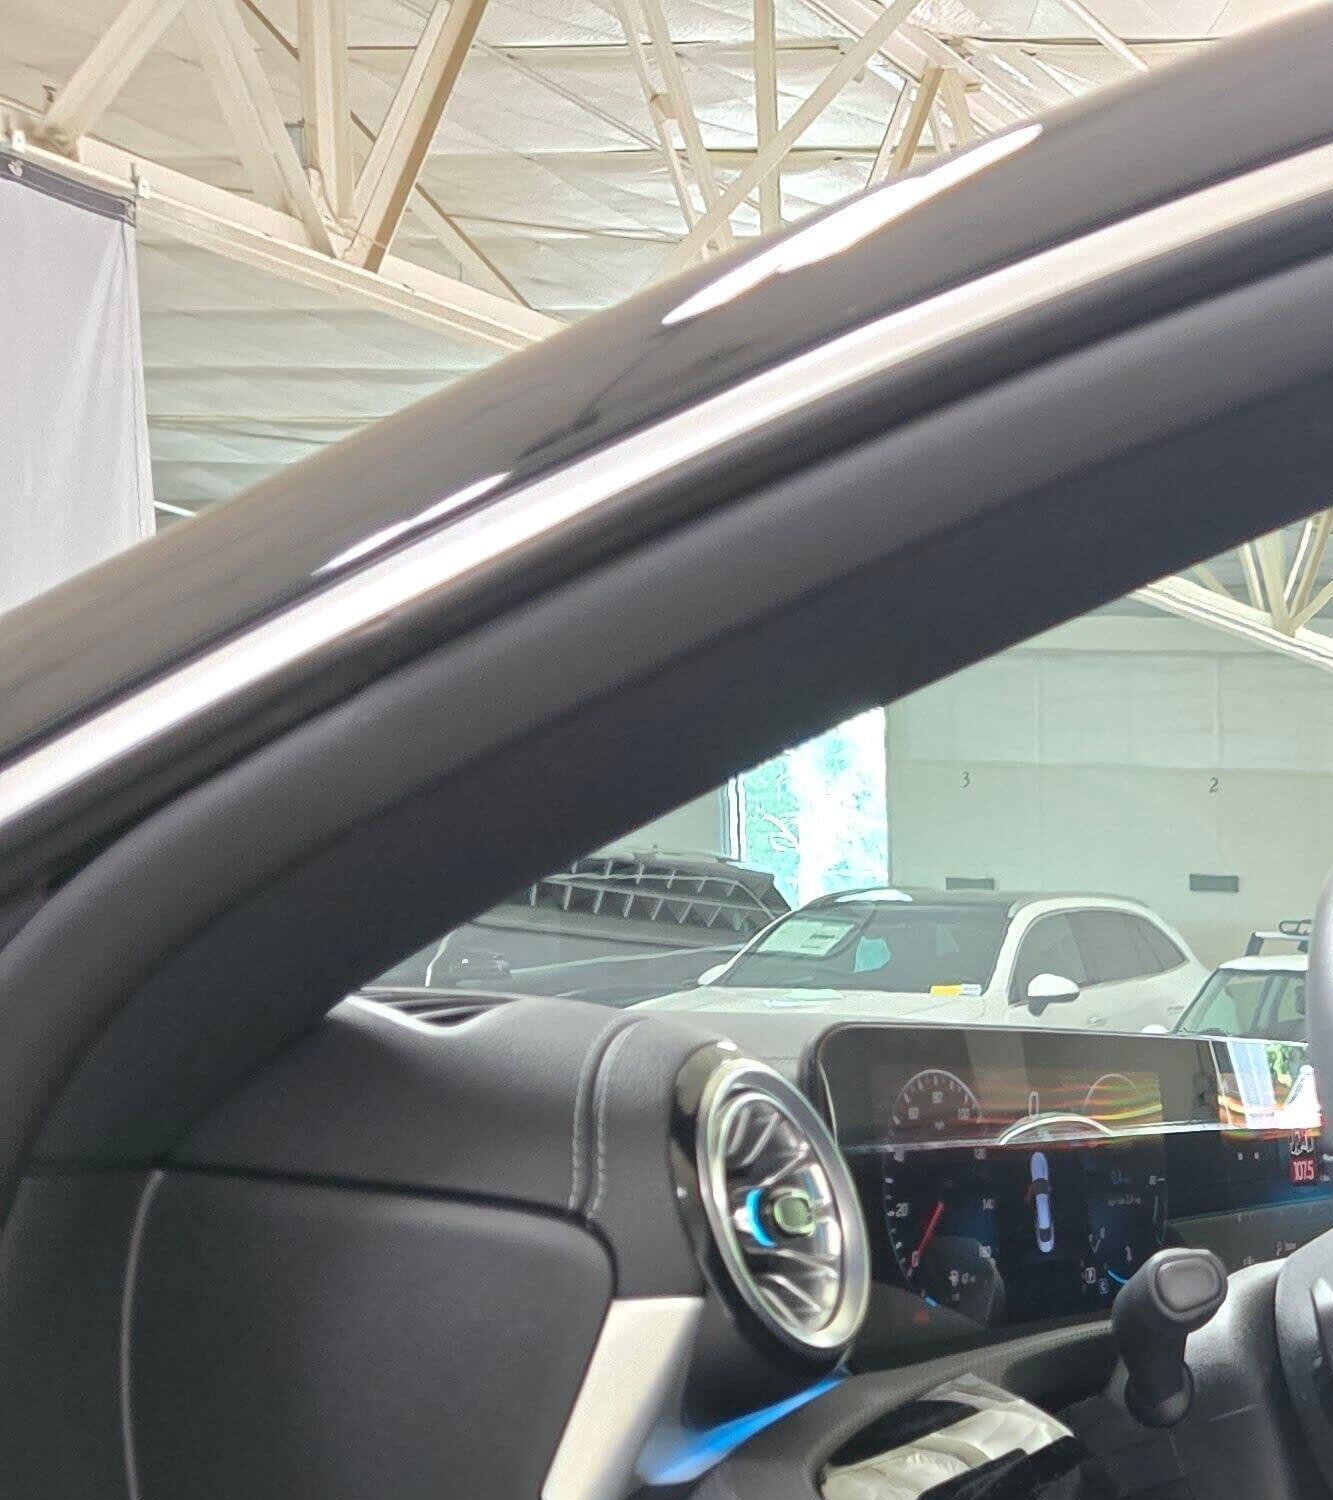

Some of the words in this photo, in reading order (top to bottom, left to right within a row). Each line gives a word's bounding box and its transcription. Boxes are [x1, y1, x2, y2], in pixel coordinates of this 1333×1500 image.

[960, 770, 971, 788] 3
[1208, 776, 1220, 793] 2
[895, 1202, 909, 1218] 20
[911, 1250, 920, 1268] 0
